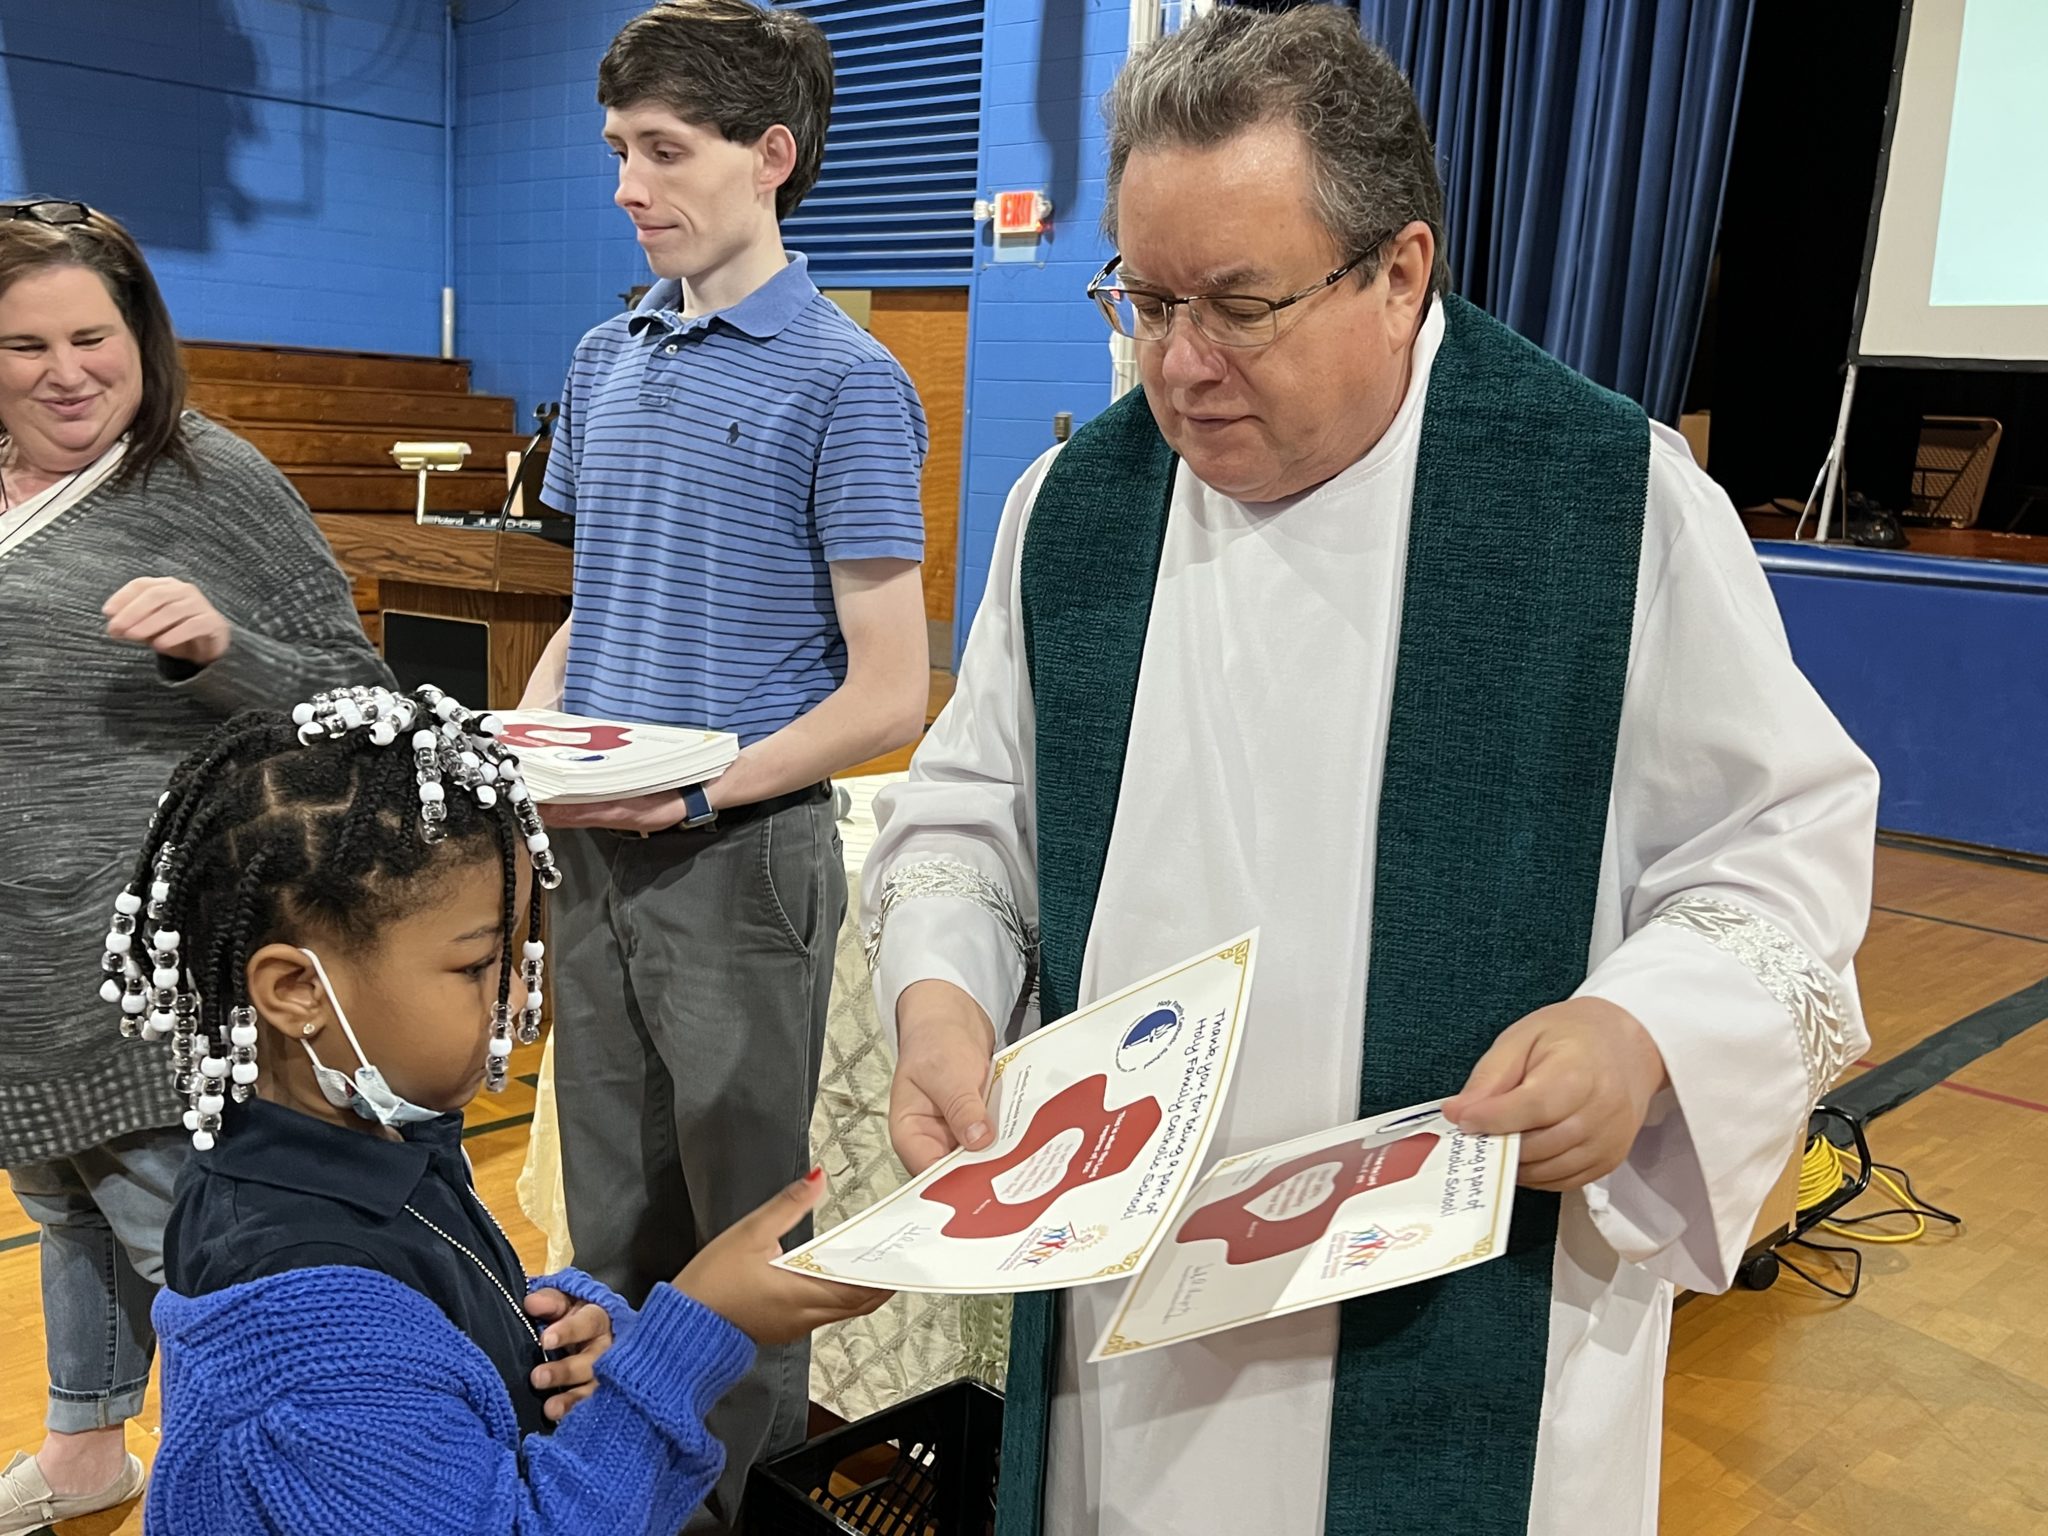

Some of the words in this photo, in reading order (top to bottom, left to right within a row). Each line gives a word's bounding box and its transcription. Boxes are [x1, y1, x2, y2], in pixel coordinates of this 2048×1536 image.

[1000, 192, 1034, 227] EXIT
[434, 516, 464, 526] Roland
[1184, 1017, 1207, 1056] Holy
[1204, 1008, 1226, 1060] Thank
[1168, 1056, 1198, 1112] Family
[1196, 1062, 1213, 1091] you
[1189, 1093, 1208, 1113] for
[1169, 1115, 1201, 1158] being
[1166, 1160, 1179, 1169] a
[1152, 1170, 1174, 1199] part
[1464, 1174, 1484, 1197] part
[1138, 1202, 1158, 1215] of
[1459, 1199, 1486, 1211] of
